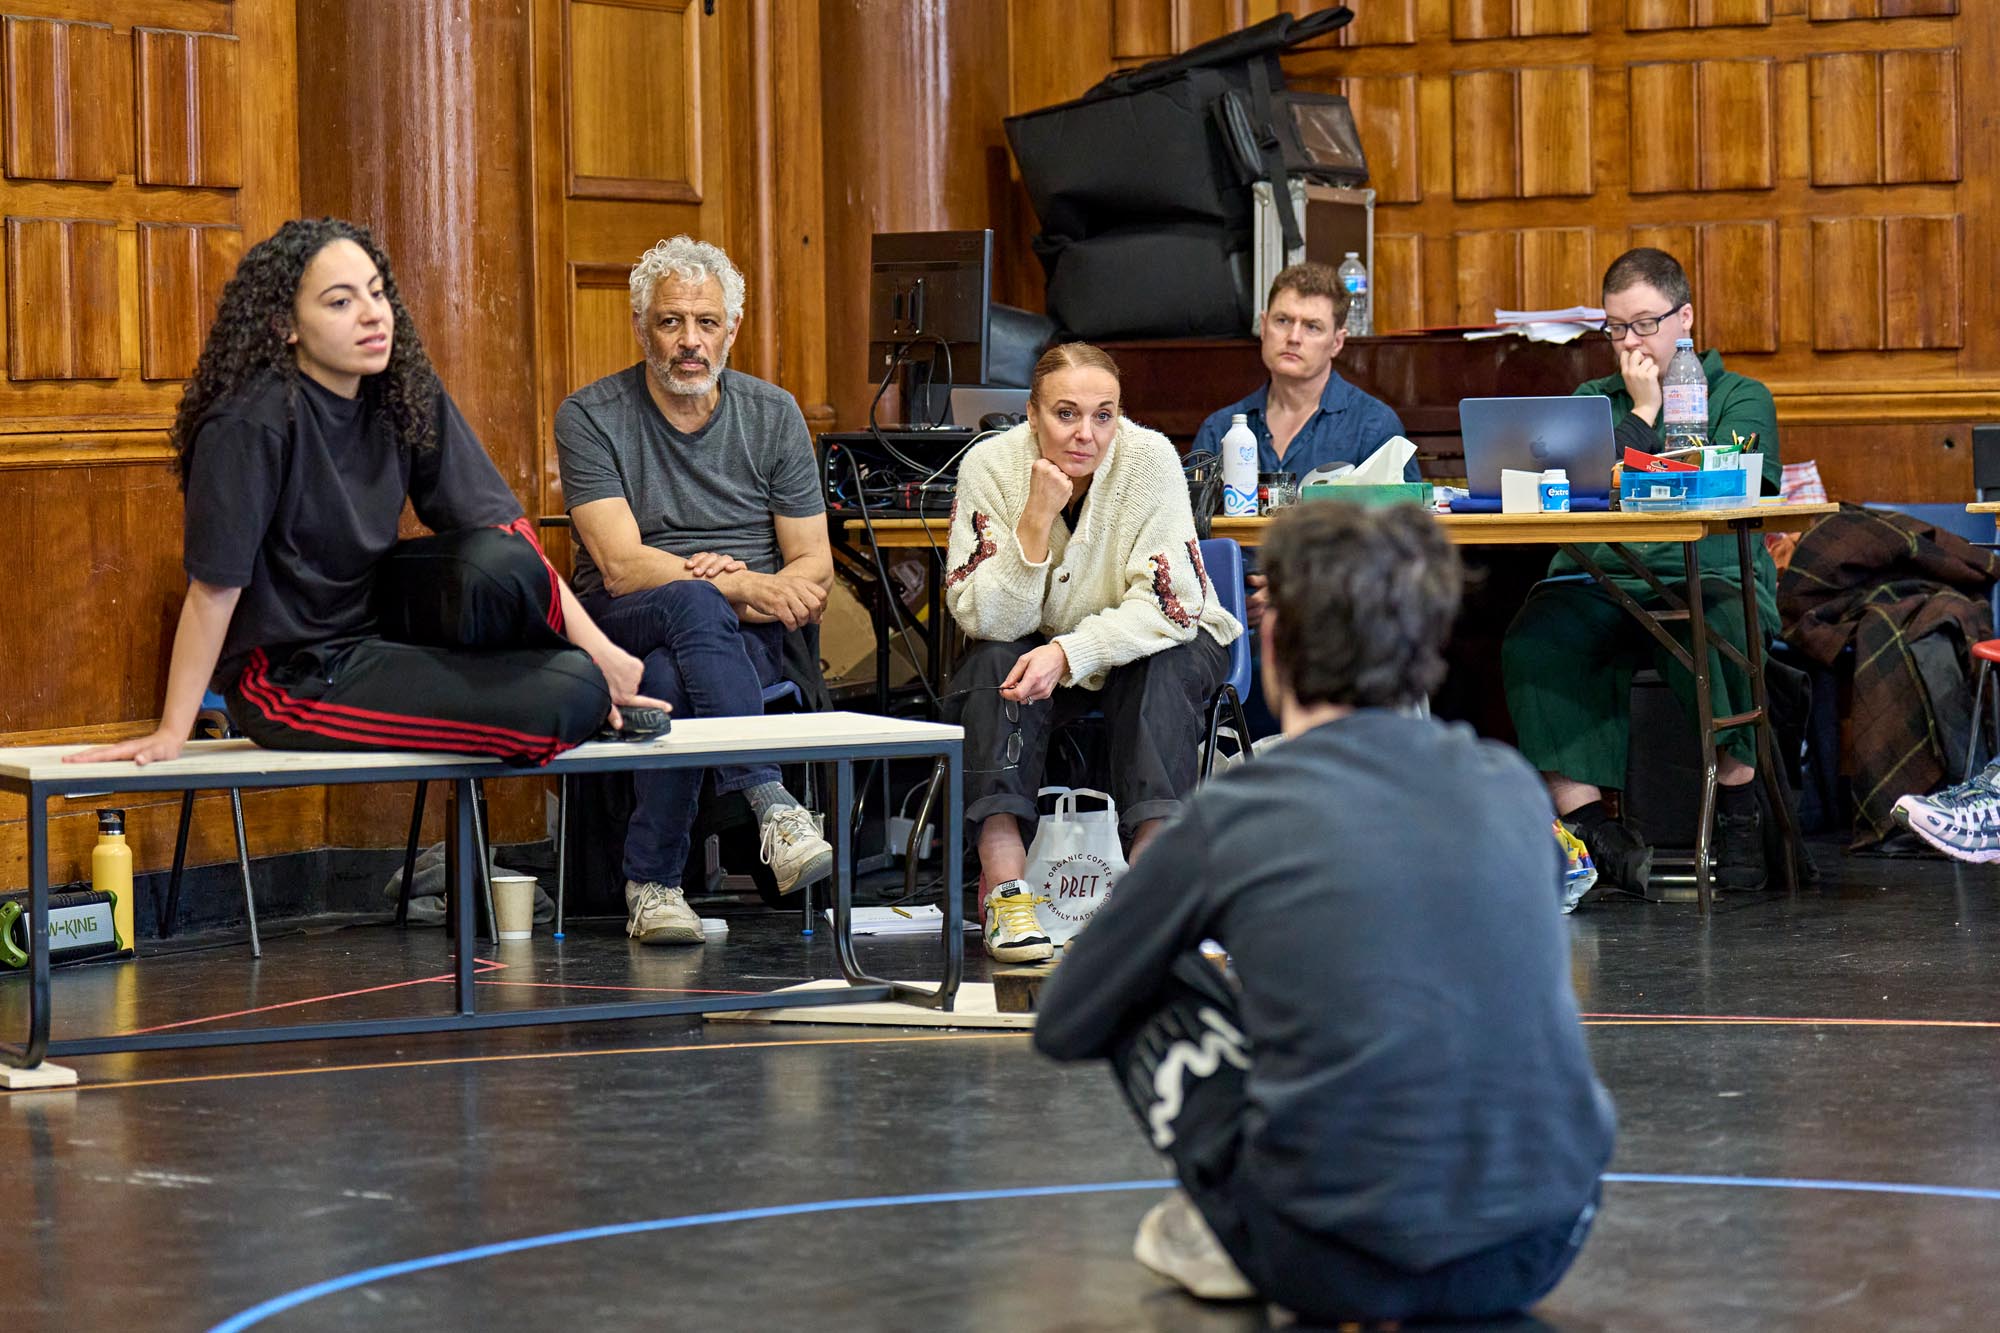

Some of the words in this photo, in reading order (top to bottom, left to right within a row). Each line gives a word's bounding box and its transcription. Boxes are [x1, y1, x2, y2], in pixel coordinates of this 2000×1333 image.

[1548, 488, 1569, 497] extra
[1048, 853, 1083, 878] ORGANIC
[1086, 854, 1112, 877] COFFEE
[1059, 875, 1100, 899] PRET
